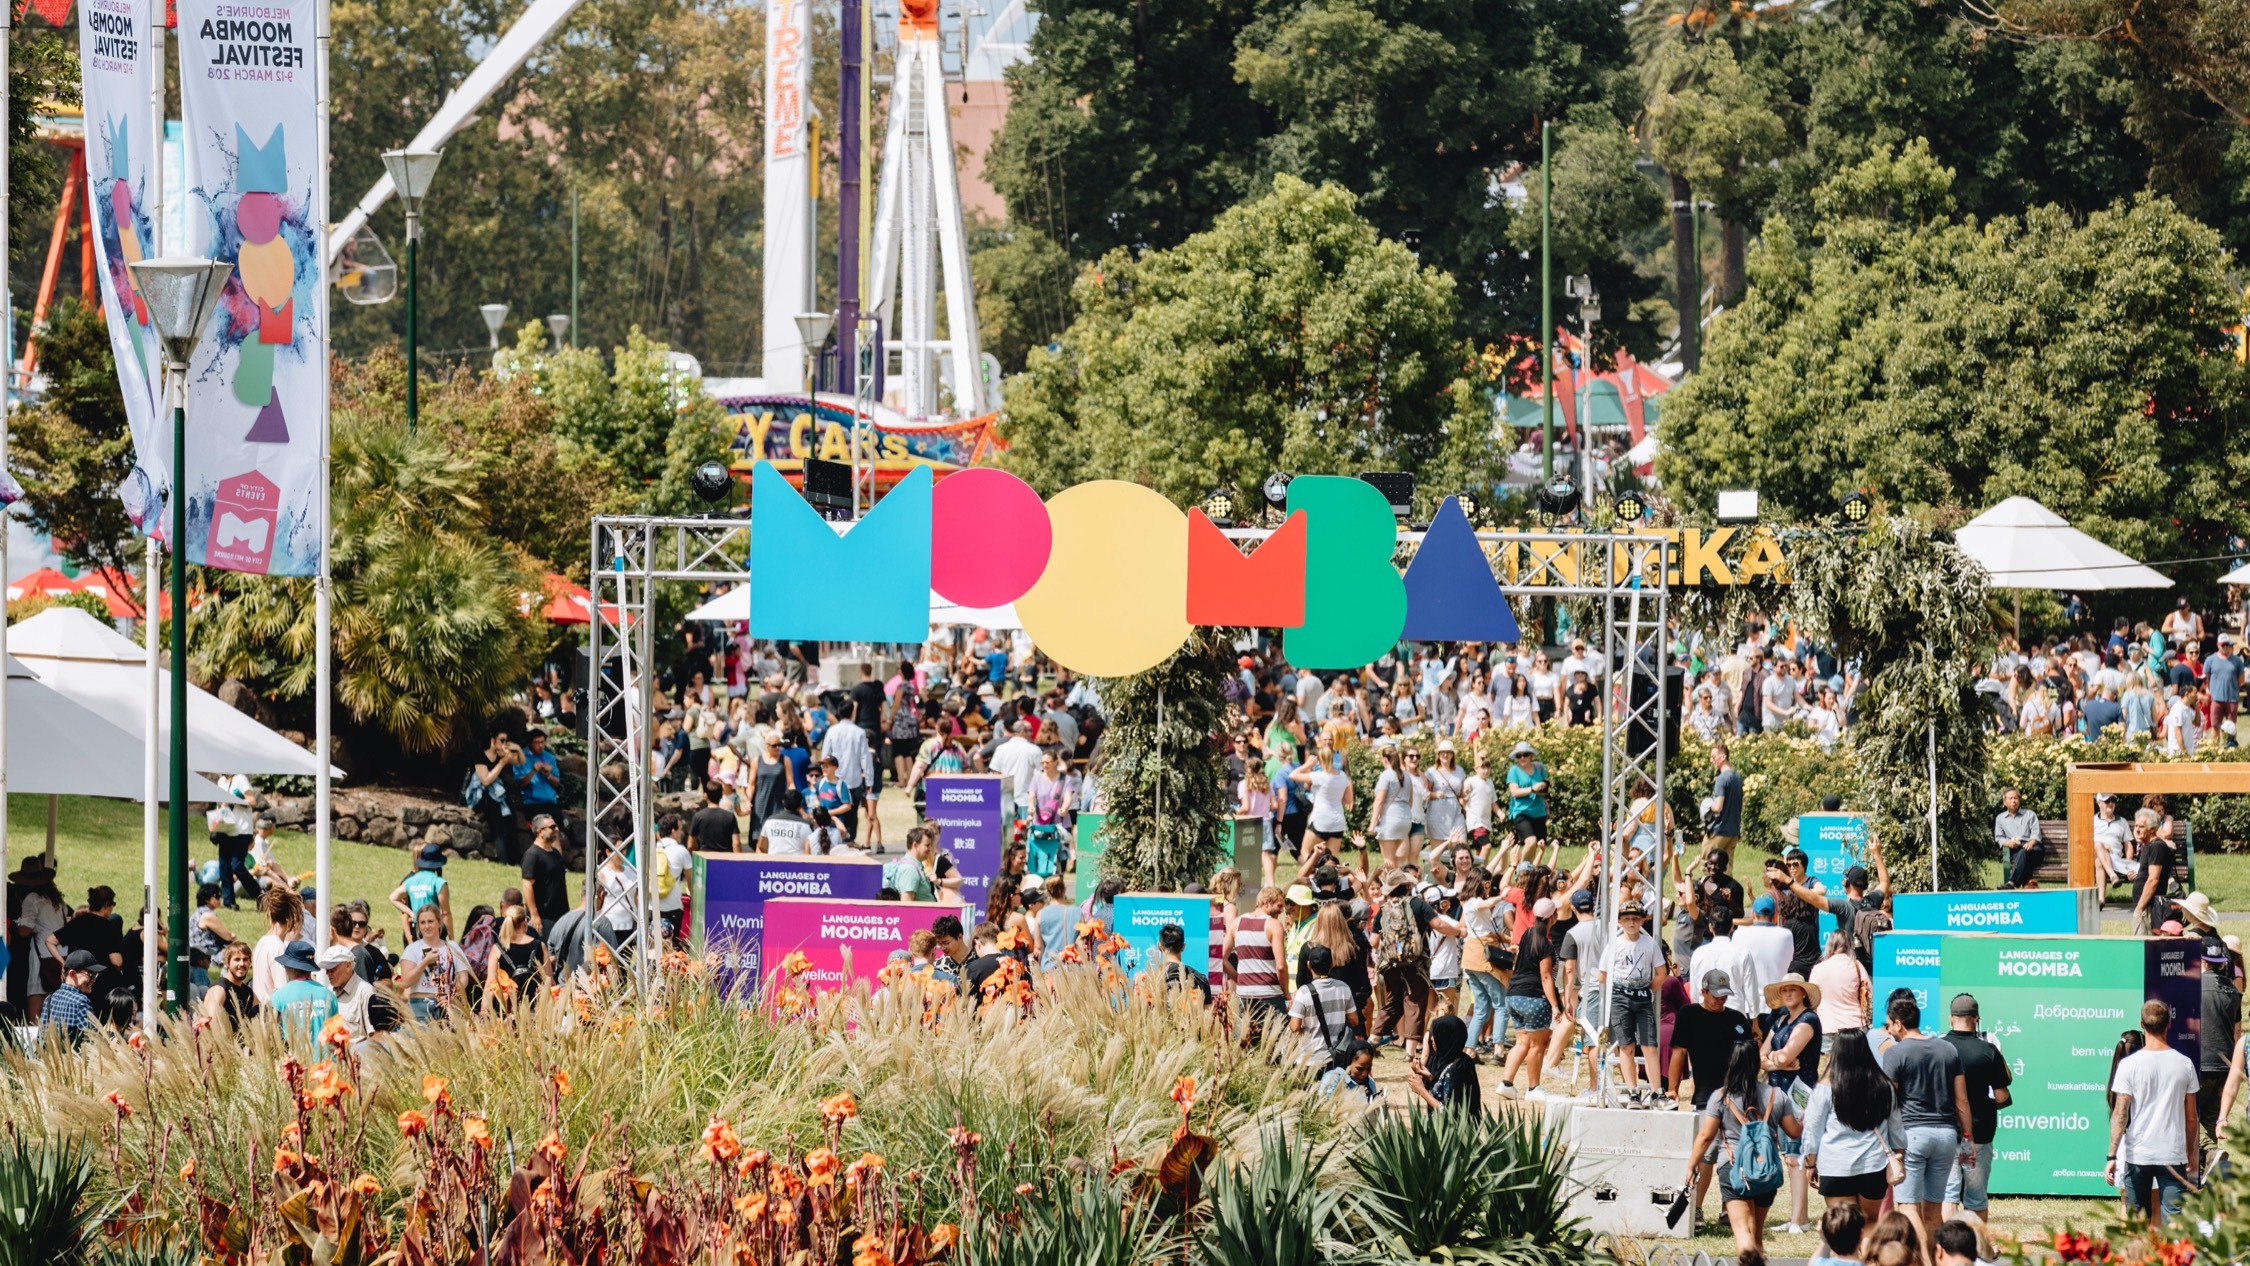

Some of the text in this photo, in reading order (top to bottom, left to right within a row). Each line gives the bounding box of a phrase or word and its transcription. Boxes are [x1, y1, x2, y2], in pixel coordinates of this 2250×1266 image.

[789, 412, 909, 460] CARS
[749, 458, 1521, 679] MOOMBA
[941, 794, 985, 803] MOOMBA
[937, 818, 982, 829] Wominjeka
[771, 829, 794, 839] 1960
[1813, 857, 1845, 874] 환영
[760, 871, 830, 881] LANGUAGES OF
[759, 881, 832, 895] MOOMBA
[1948, 902, 2020, 912] LANGUAGES OF
[822, 915, 900, 925] LANGUAGES OF
[1131, 916, 1185, 927] MOOMBA
[1947, 912, 2023, 927] MOOMBA
[821, 925, 902, 941] MOOMBA
[1896, 948, 1939, 956] LANGUAGES
[1999, 950, 2080, 961] LANGUAGES OF
[1998, 961, 2083, 977] MOOMBA
[2160, 962, 2186, 977] MOOMBA
[2033, 1004, 2124, 1021] Добродошли
[2071, 1046, 2095, 1057] bem
[2047, 1081, 2106, 1092] kuwakaribisha
[1997, 1111, 2090, 1131] ienvenido
[2001, 1149, 2032, 1162] venit
